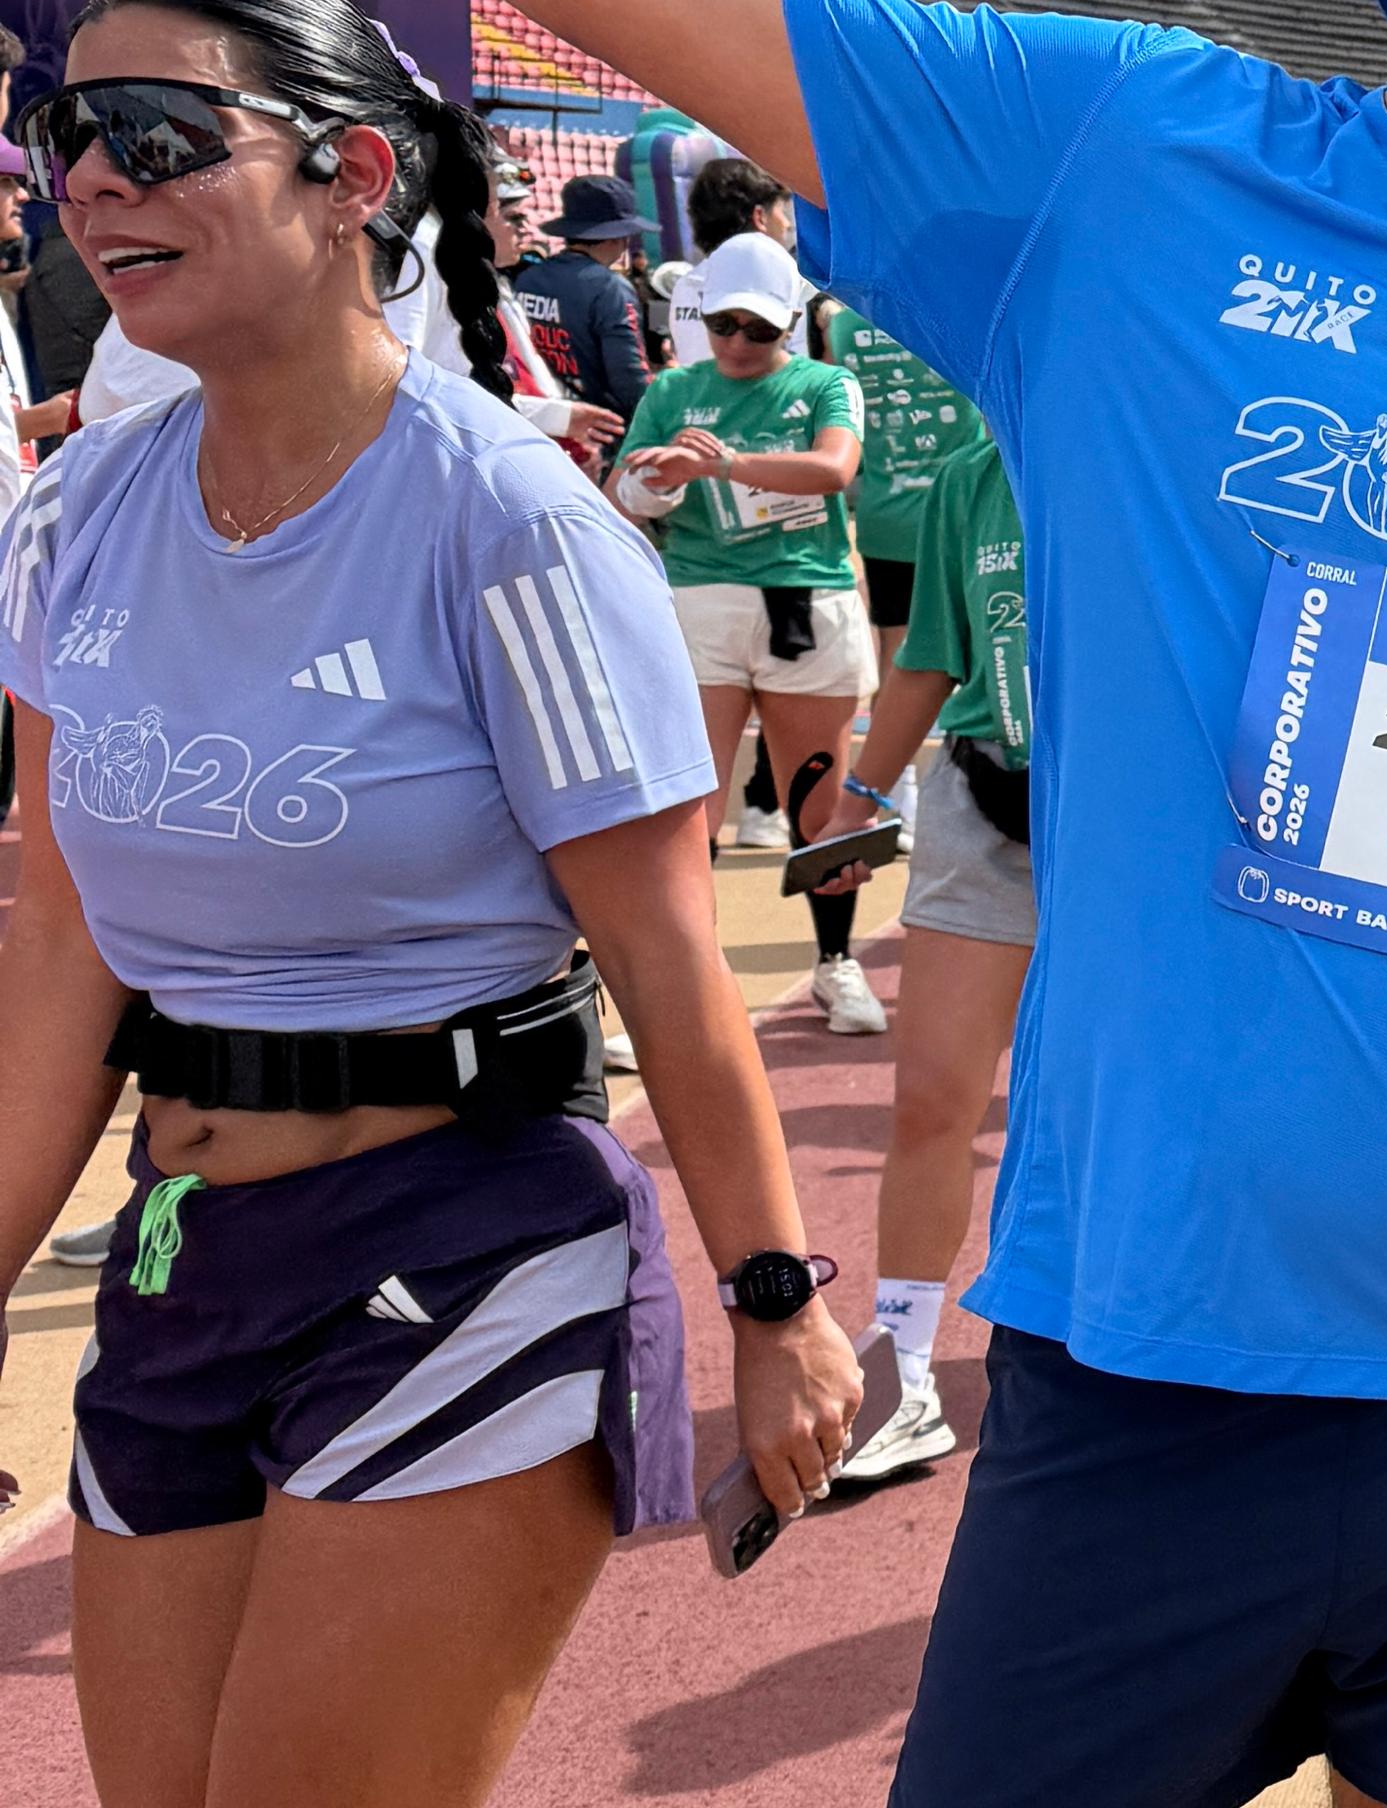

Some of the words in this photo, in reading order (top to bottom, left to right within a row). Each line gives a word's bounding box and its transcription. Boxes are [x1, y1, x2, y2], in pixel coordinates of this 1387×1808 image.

[1238, 253, 1377, 306] QUITO
[1306, 560, 1357, 586] CORRAL
[1256, 587, 1329, 842] CORPORATIVO
[1283, 782, 1310, 846] 2026
[1273, 887, 1348, 924] SPORT
